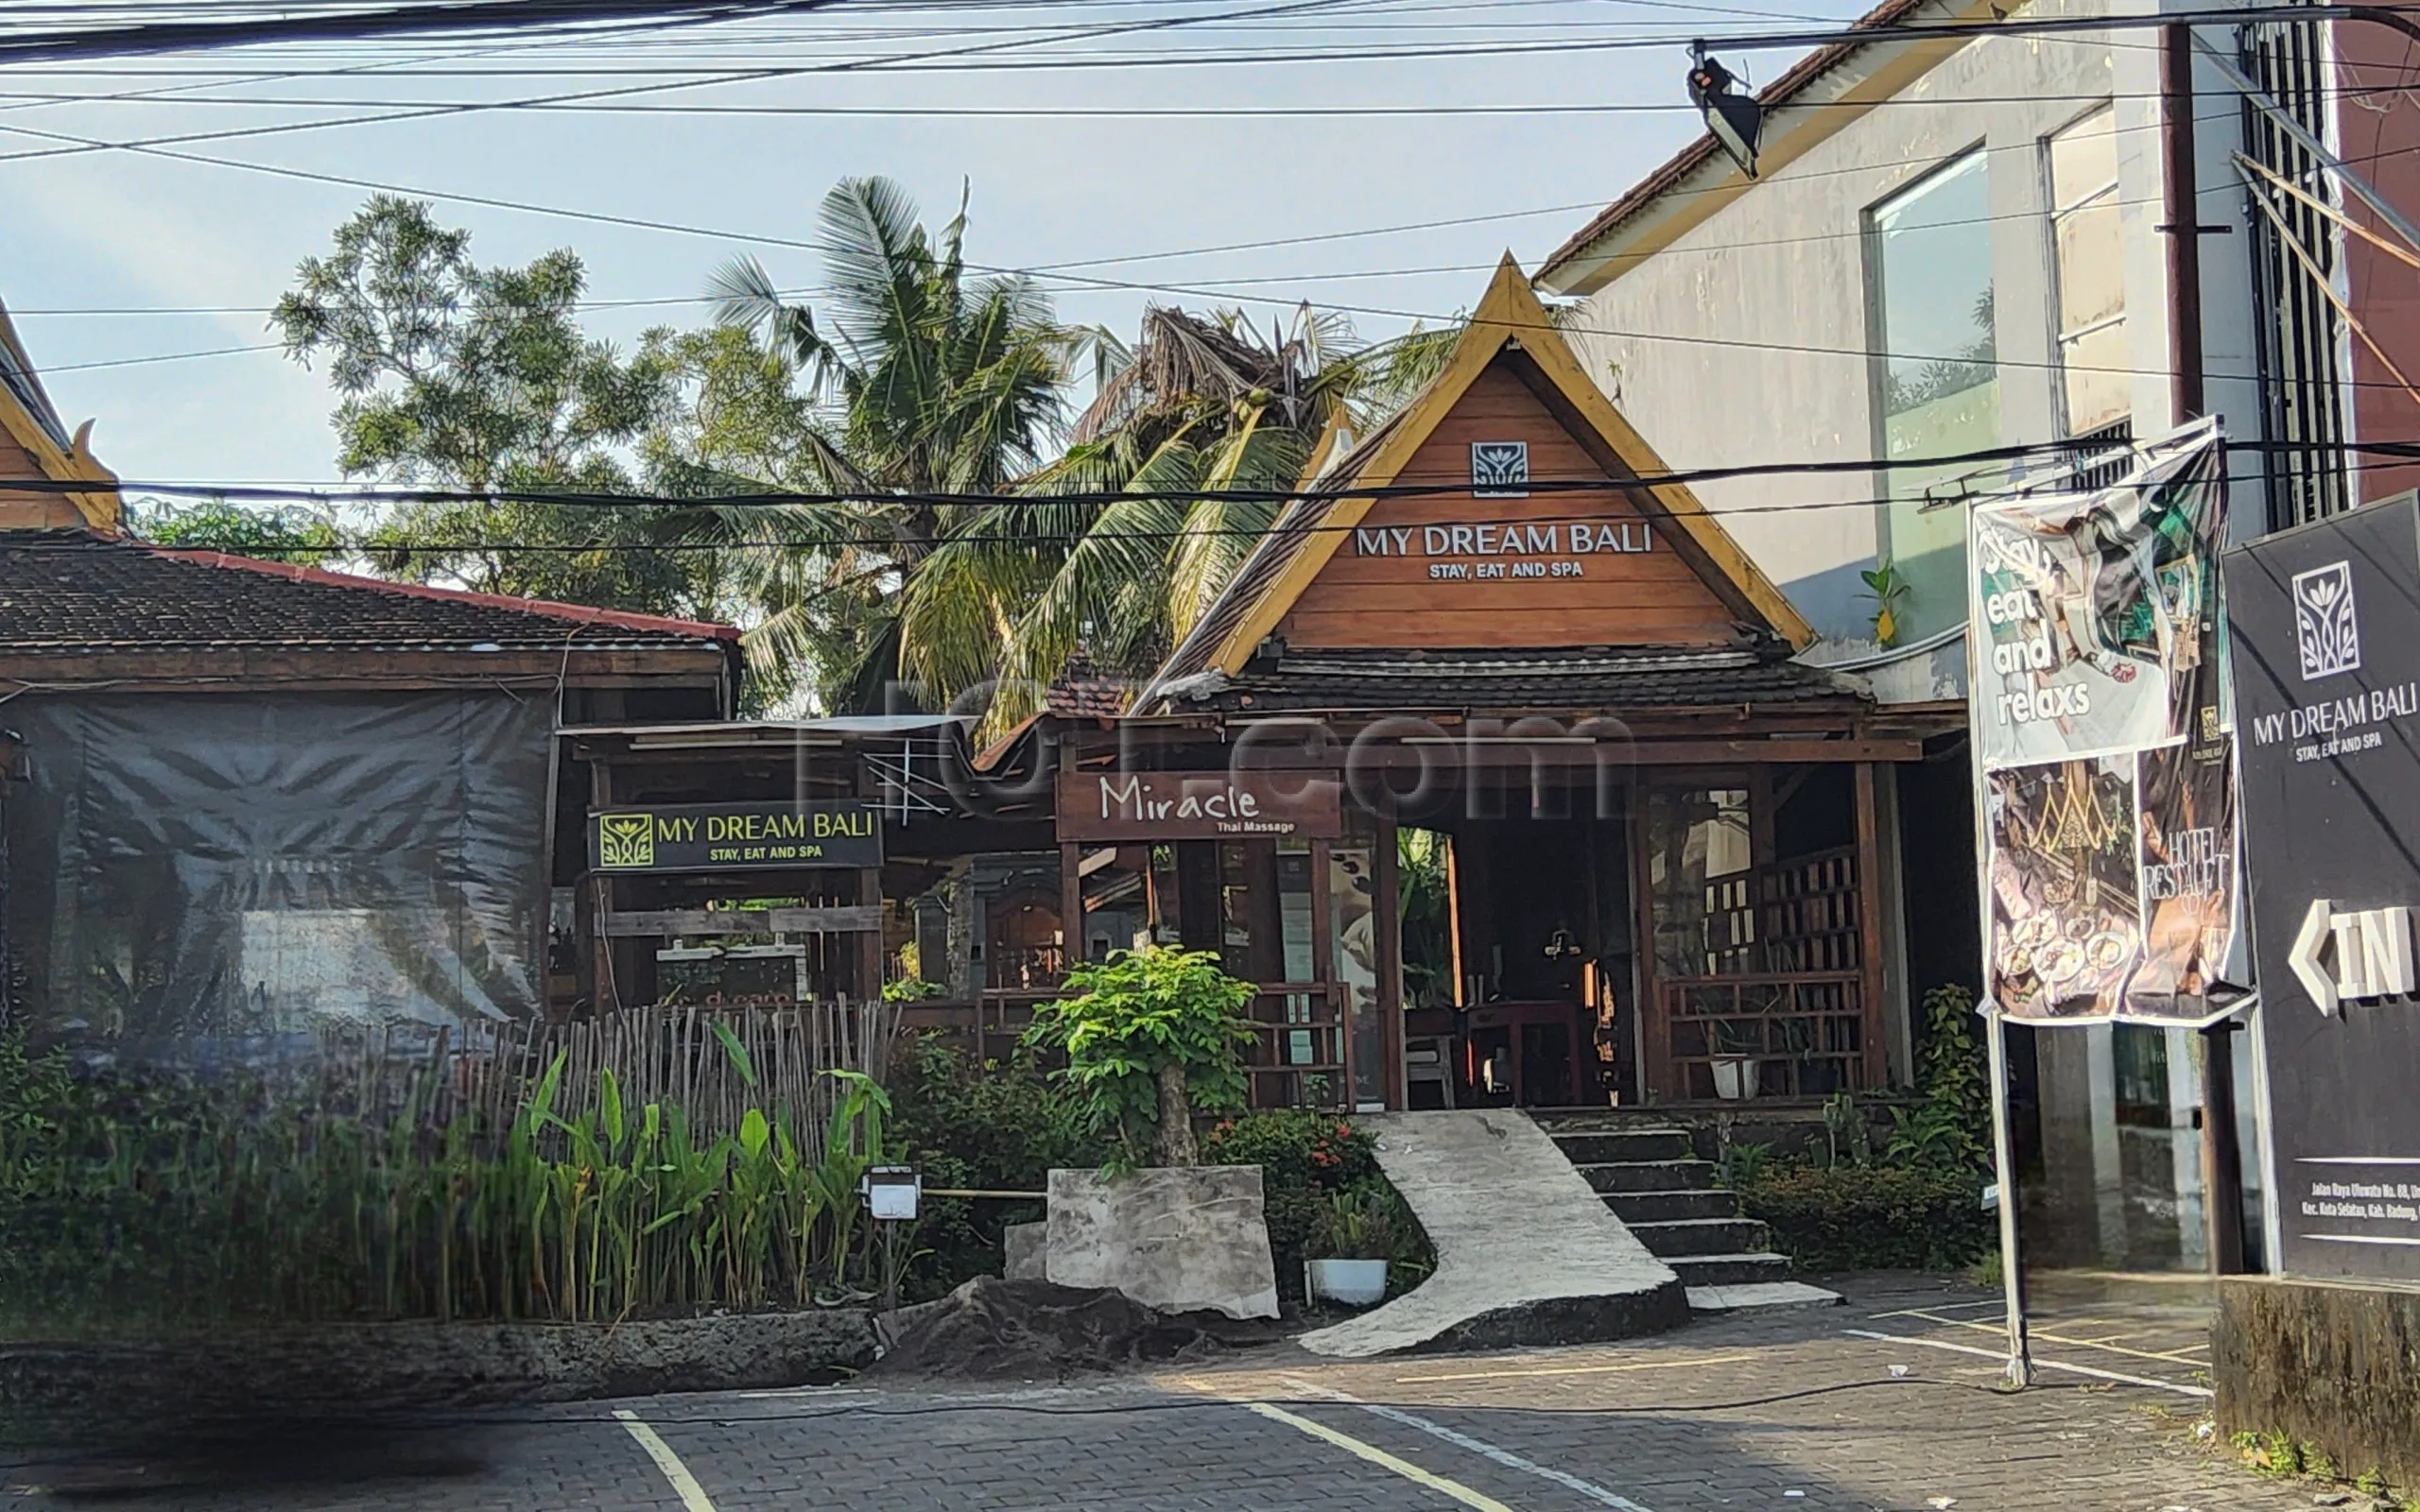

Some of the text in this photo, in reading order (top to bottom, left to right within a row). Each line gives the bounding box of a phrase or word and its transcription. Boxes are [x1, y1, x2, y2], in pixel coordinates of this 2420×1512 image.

[1357, 524, 1651, 557] MY DREAM BALI
[1429, 562, 1583, 580] STAY, EAT AND SPA
[1987, 590, 2038, 625] eat
[1993, 618, 2052, 675] and
[1996, 672, 2090, 726] relaxs
[2254, 681, 2418, 747] MY DREAM BALI
[2296, 731, 2382, 763] STAY, EAT AND SPA
[1099, 775, 1260, 821] Miracle
[658, 811, 873, 843] MY DREAM BALI
[1218, 821, 1296, 834] Thai Massage
[710, 845, 822, 862] STAY, EAT AND SPA
[2329, 905, 2415, 1000] IN
